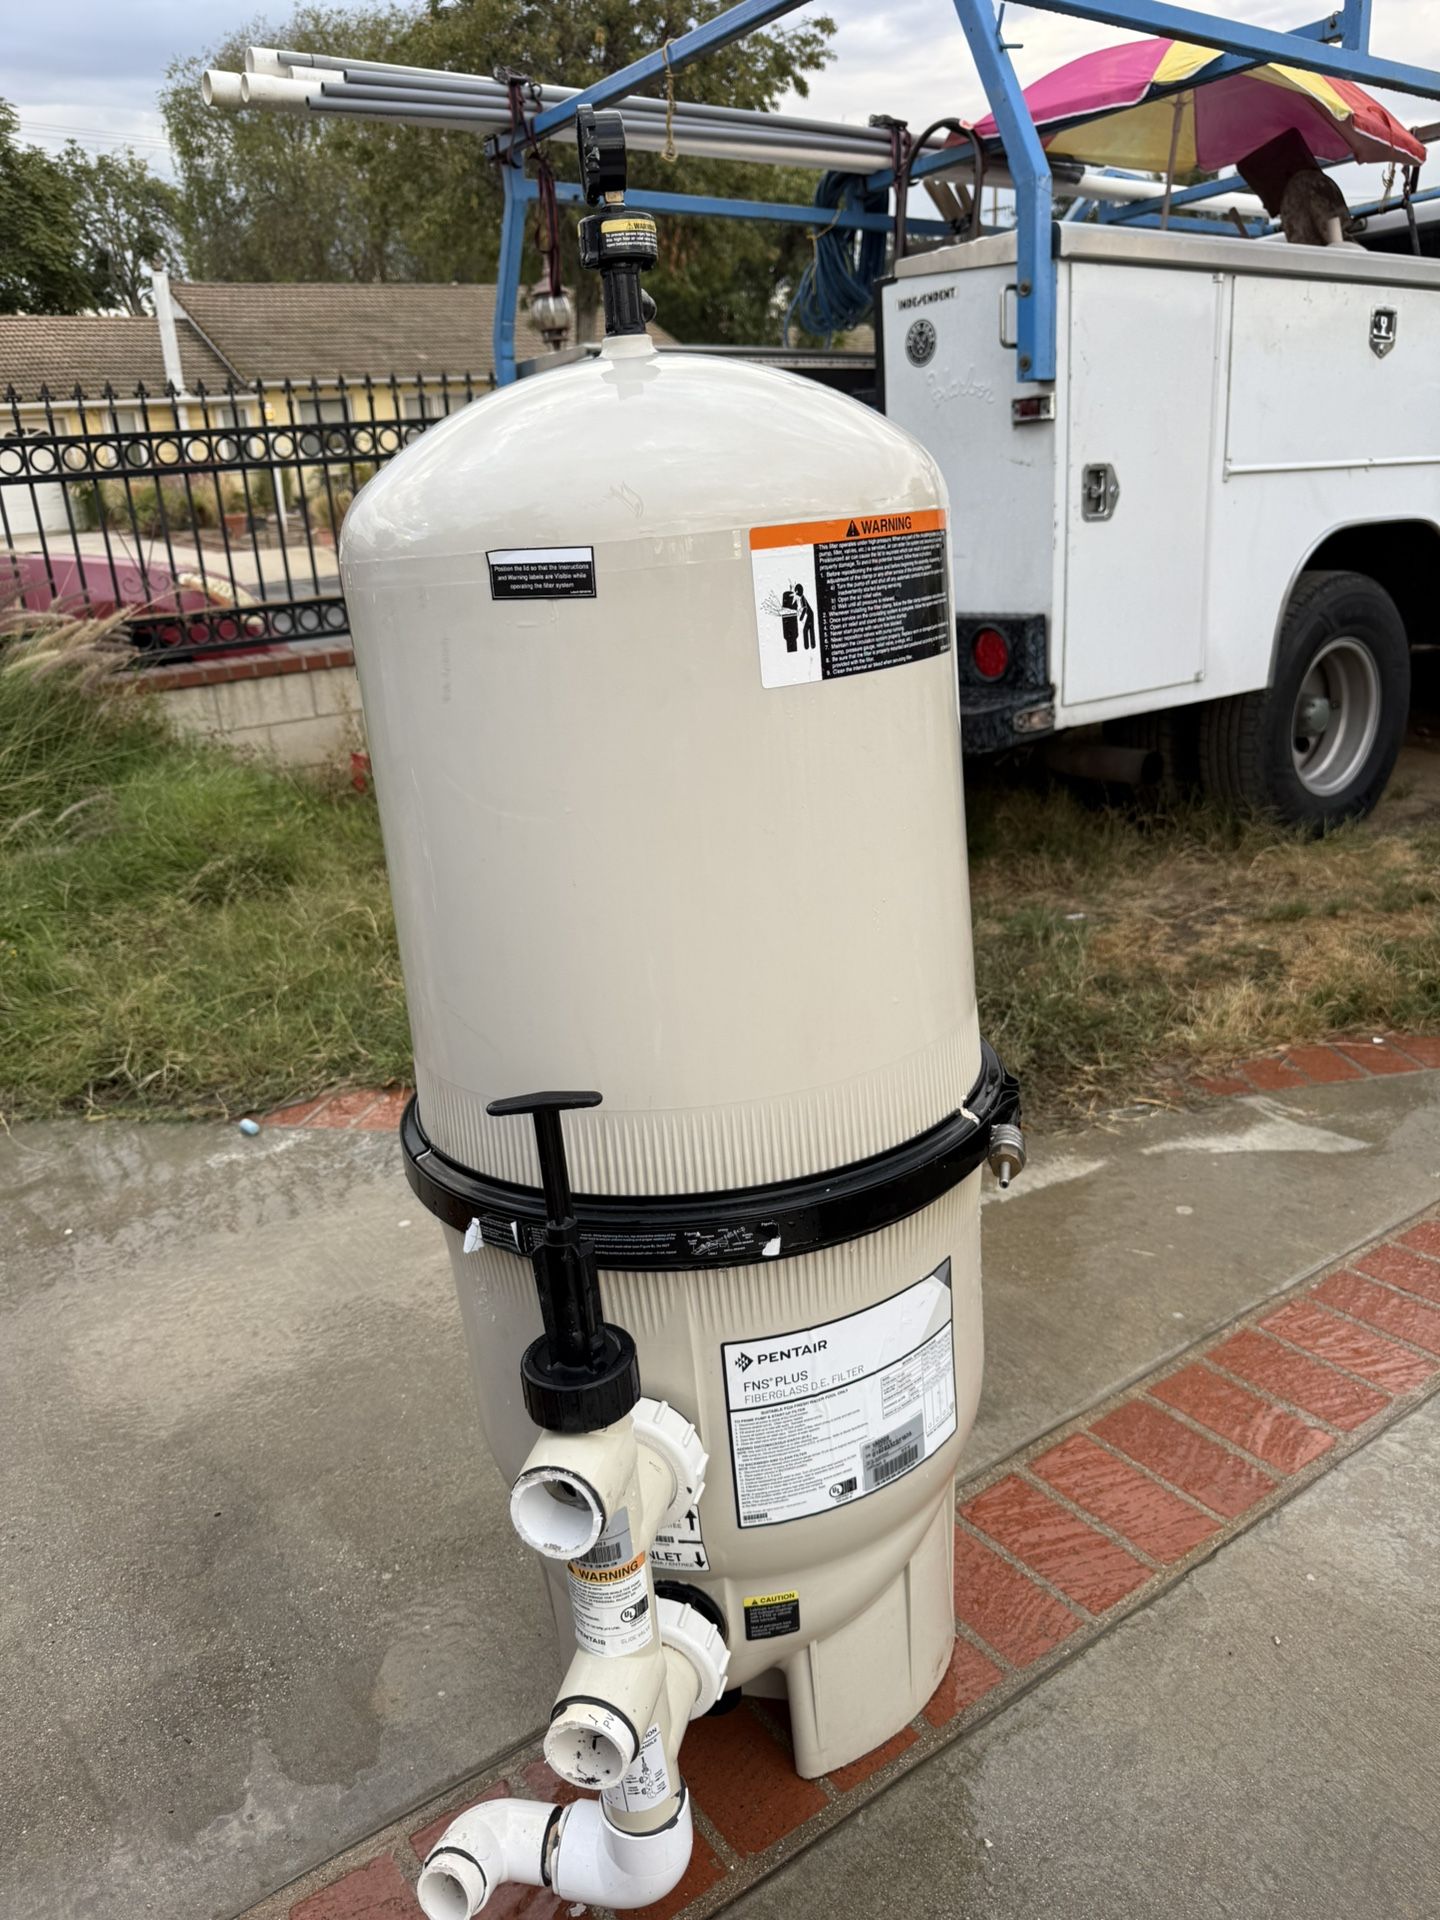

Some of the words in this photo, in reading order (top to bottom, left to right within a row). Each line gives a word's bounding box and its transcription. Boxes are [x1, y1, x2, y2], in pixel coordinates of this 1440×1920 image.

[861, 516, 911, 535] WARNING
[758, 1339, 828, 1365] PENTAIR
[744, 1384, 808, 1404] FIBERGLASS
[811, 1379, 830, 1391] D.E.
[832, 1364, 864, 1383] FILTER
[775, 1370, 808, 1386] PLUS
[649, 1551, 682, 1562] NLET
[579, 1560, 638, 1581] WARNING
[760, 1593, 795, 1603] CAUTION
